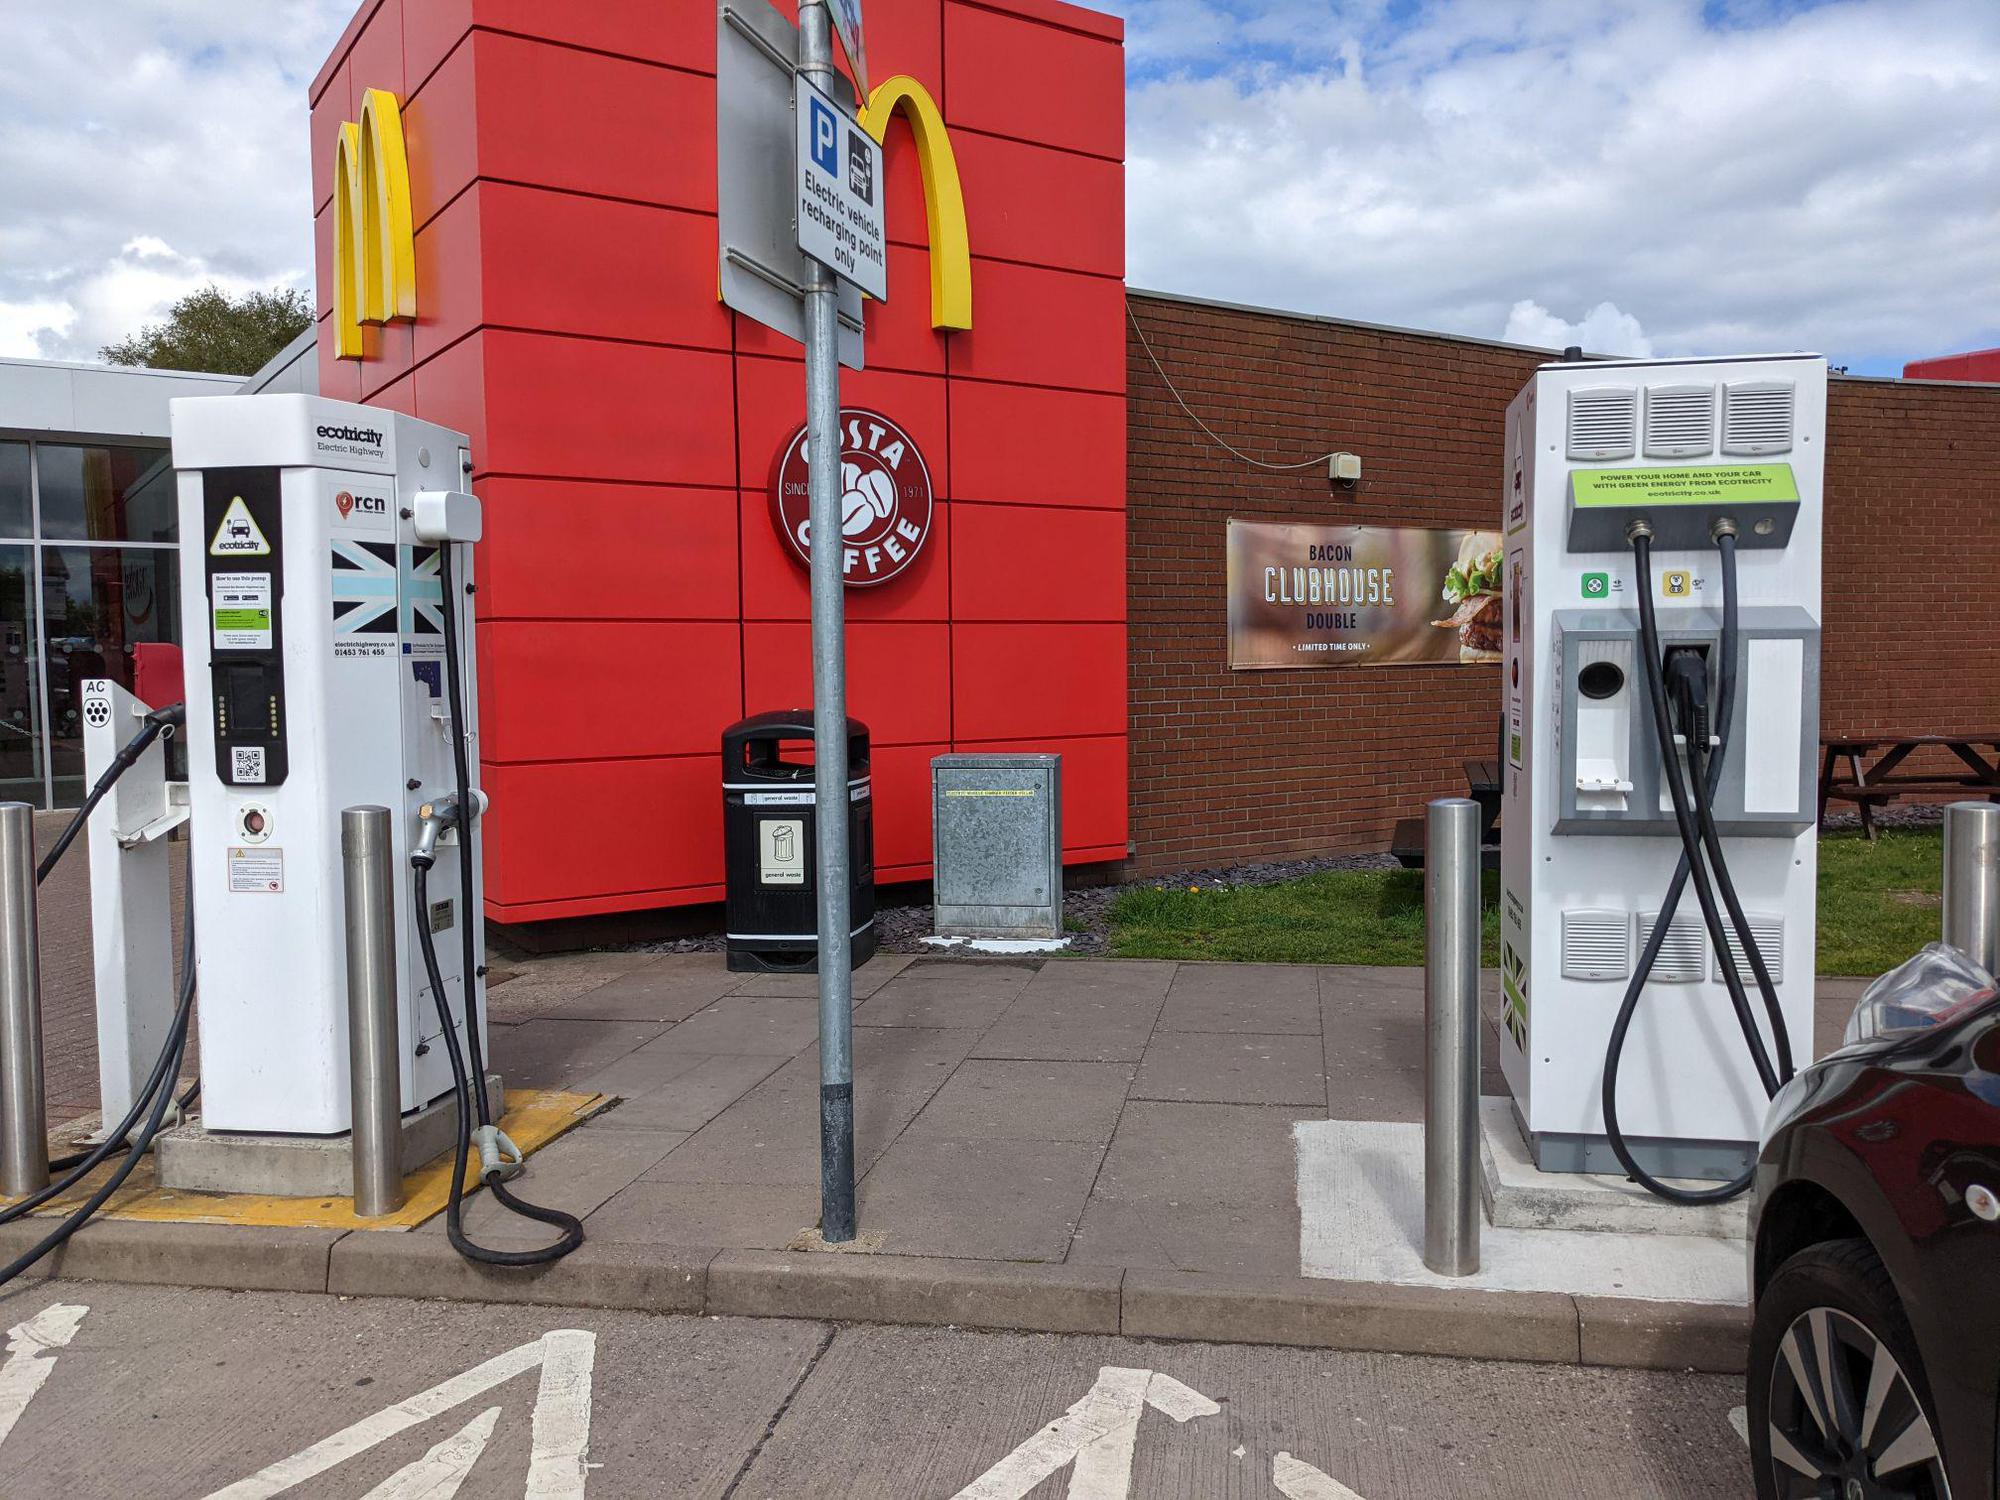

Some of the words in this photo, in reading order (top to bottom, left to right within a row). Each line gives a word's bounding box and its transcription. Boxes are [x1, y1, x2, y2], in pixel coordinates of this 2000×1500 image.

[817, 109, 833, 161] P
[805, 169, 844, 215] Electric
[847, 205, 880, 242] vehicle
[802, 198, 856, 249] recharging
[859, 239, 883, 267] point
[834, 246, 855, 273] only
[317, 425, 383, 447] ecotricity
[317, 442, 348, 453] Electric
[349, 445, 384, 458] Highway
[801, 419, 904, 471] STA
[1719, 478, 1772, 486] ECOTRICITY
[903, 486, 924, 498] 1971
[355, 496, 385, 511] rcn
[219, 540, 259, 551] ecotricity
[797, 517, 921, 574] CFFEE
[1309, 545, 1352, 562] BACON
[1264, 566, 1395, 606] CLUBHOUSE
[1306, 612, 1356, 630] DOUBLE
[334, 648, 356, 656] 01453
[1297, 643, 1328, 651] LIMITED
[1329, 643, 1346, 651] TIME
[1347, 642, 1366, 650] ONLY
[86, 680, 105, 693] AC
[765, 871, 784, 879] general
